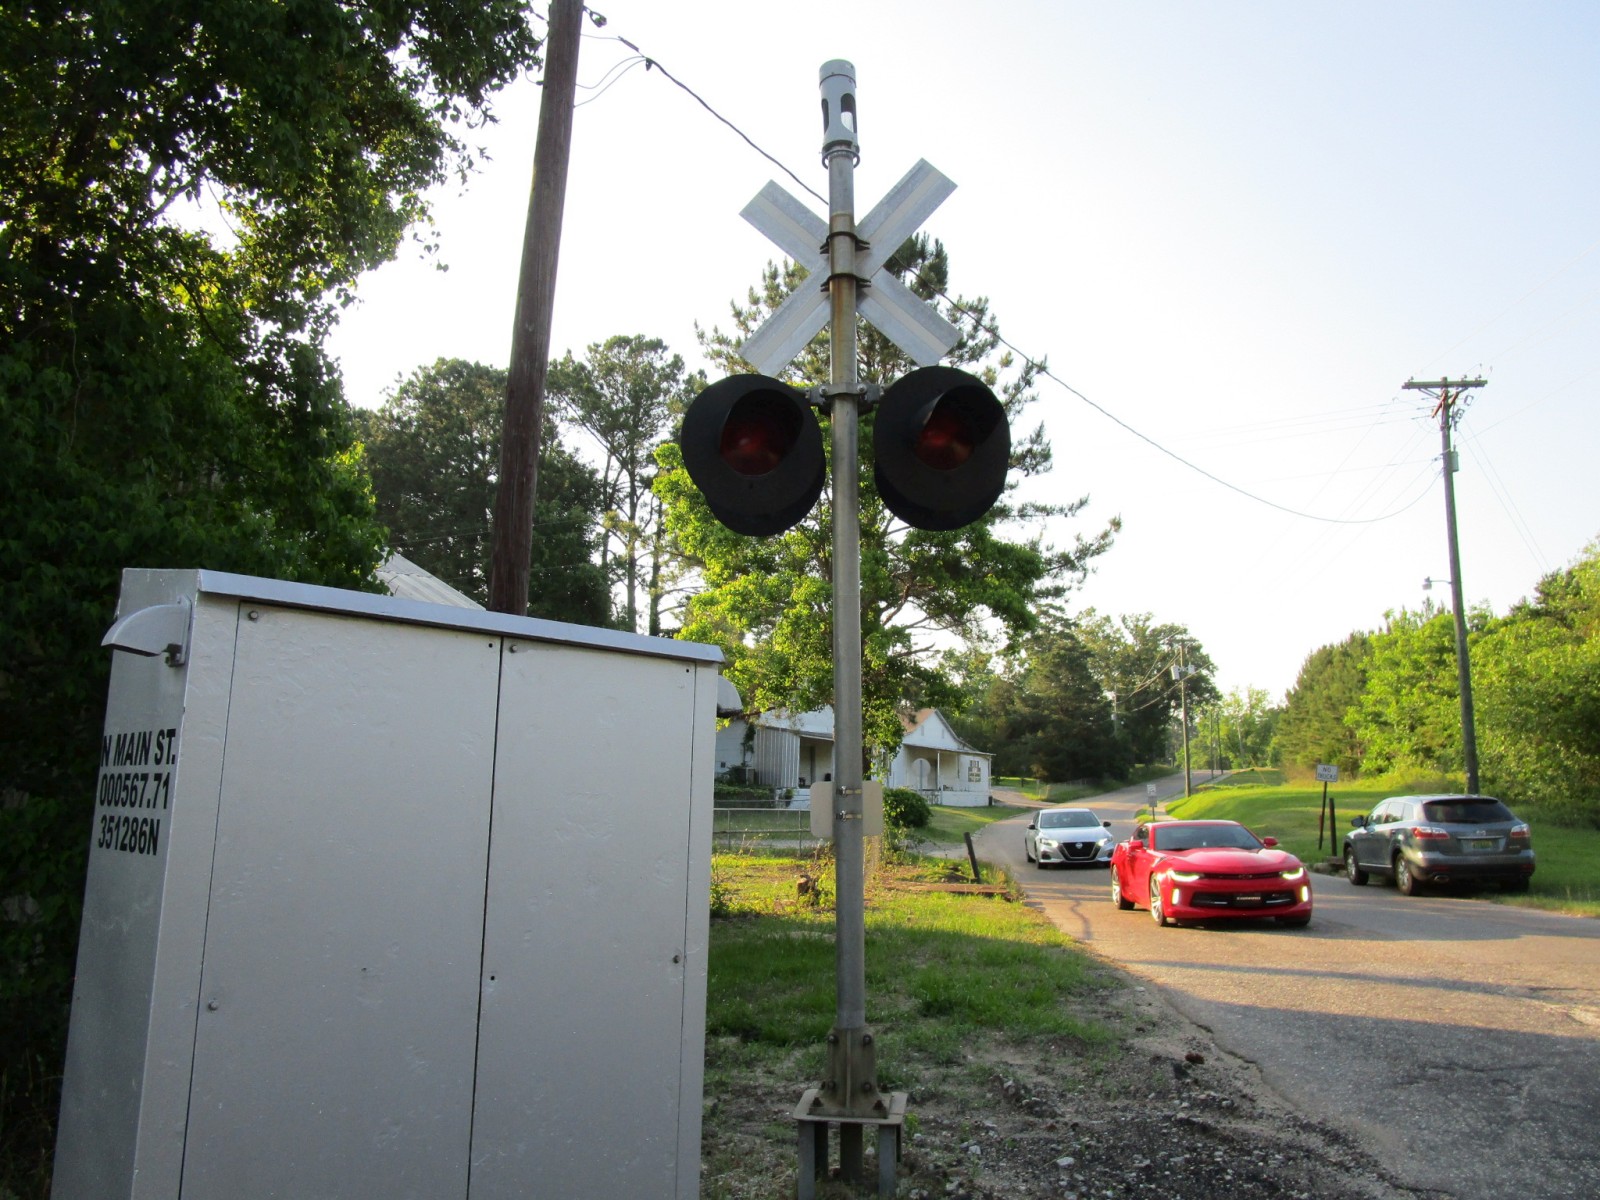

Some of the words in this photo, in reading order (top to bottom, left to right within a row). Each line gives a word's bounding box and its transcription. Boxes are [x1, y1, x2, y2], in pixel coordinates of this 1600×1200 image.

[101, 735, 112, 767] N
[113, 731, 152, 766] MAIN
[154, 728, 176, 765] ST.
[99, 772, 170, 809] 000567.71
[98, 814, 160, 856] 351286N
